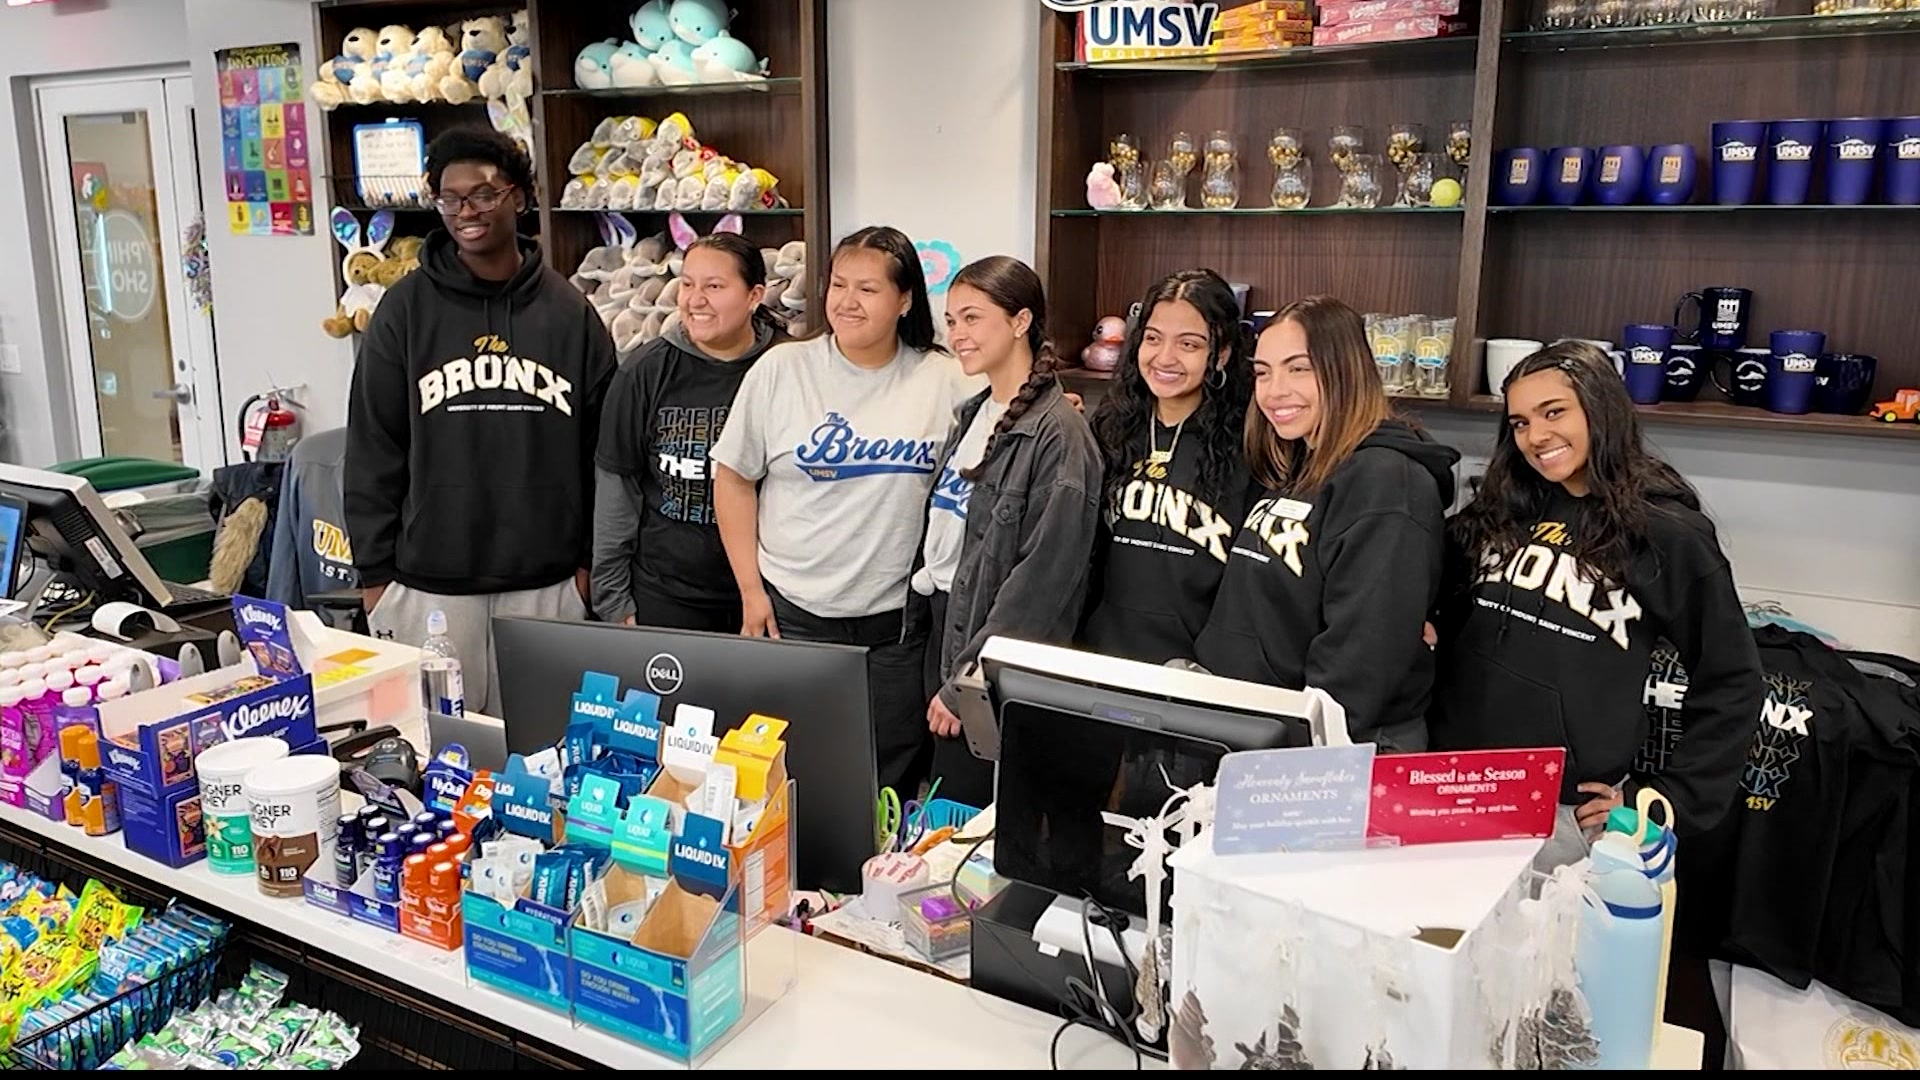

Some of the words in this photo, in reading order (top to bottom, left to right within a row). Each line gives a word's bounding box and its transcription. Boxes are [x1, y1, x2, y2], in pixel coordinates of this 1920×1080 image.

[1090, 6, 1215, 46] UMSV
[473, 335, 509, 353] The
[418, 354, 572, 416] BRONX
[826, 412, 848, 425] The
[797, 422, 936, 464] Bronx
[658, 453, 706, 480] THE
[809, 468, 837, 479] UMSV
[1112, 480, 1232, 564] ONX
[240, 604, 282, 630] Kleenex
[650, 668, 680, 682] DELL
[221, 694, 310, 741] Kleenex
[575, 700, 606, 718] LIQUID
[613, 718, 645, 738] LIQUID
[668, 735, 702, 753] LIQUID
[1409, 768, 1456, 785] Blessed
[1457, 772, 1466, 783] is
[1467, 771, 1482, 782] the
[1484, 767, 1526, 781] Season
[1249, 789, 1338, 804] ORNAMENTS
[1437, 783, 1498, 795] ORNAMENTS
[505, 803, 538, 821] LIQUID
[232, 844, 249, 855] 110
[675, 843, 712, 865] LIQUID
[279, 866, 298, 878] 110
